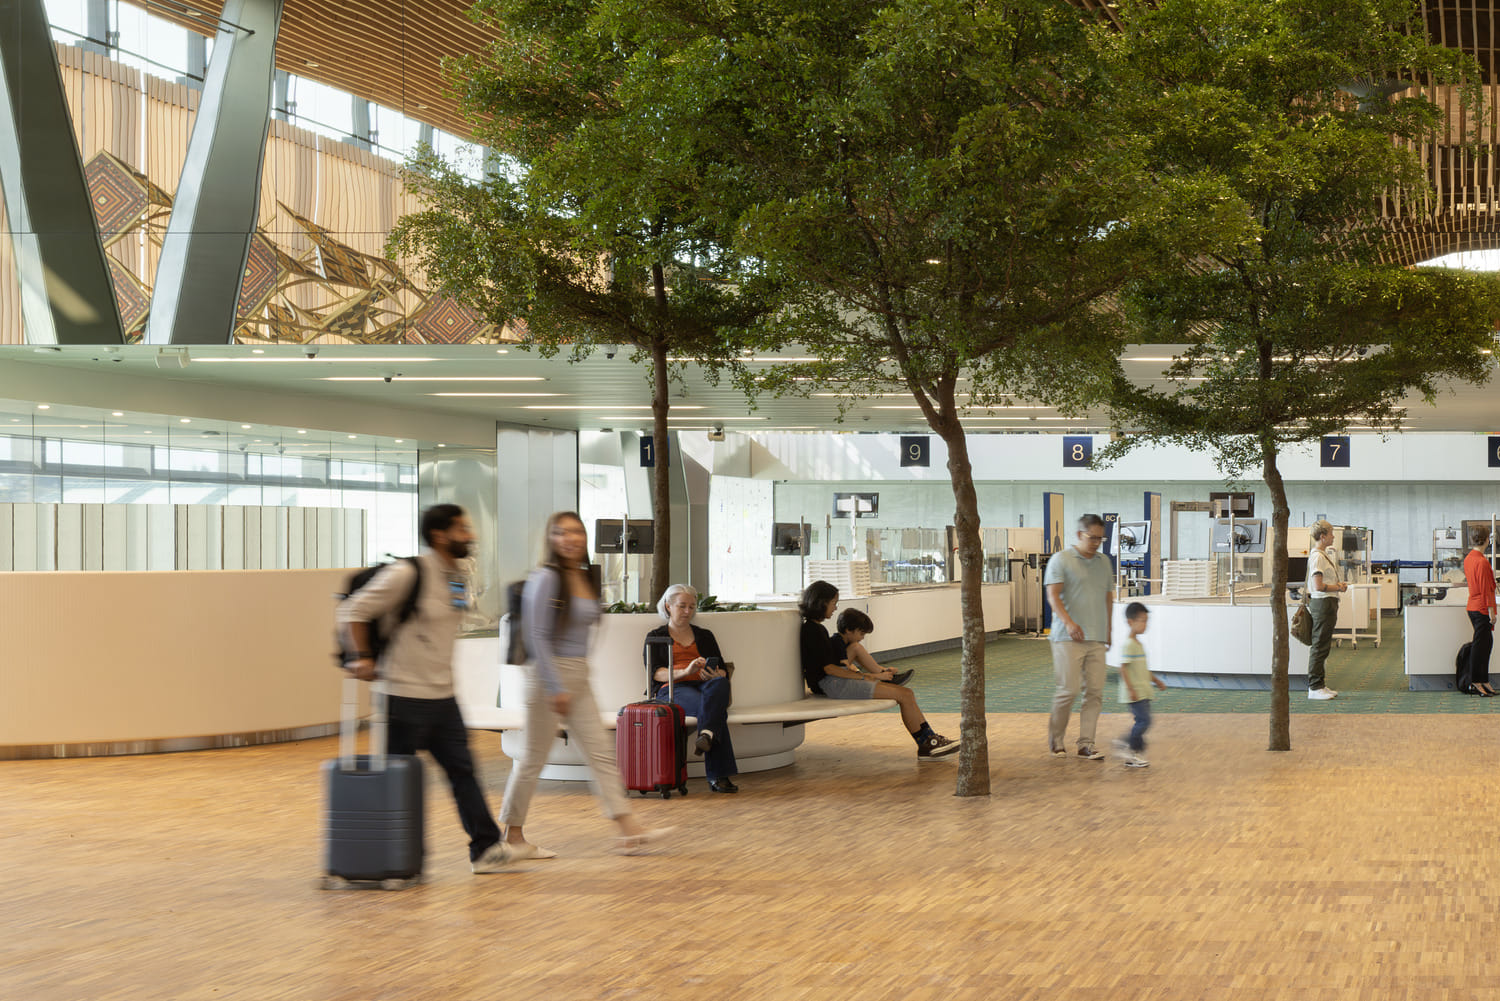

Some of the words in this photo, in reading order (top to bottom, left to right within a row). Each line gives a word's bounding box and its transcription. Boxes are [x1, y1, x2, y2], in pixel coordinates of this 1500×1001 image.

[909, 443, 921, 461] 9
[1071, 443, 1084, 461] 8
[1329, 444, 1341, 461] 7
